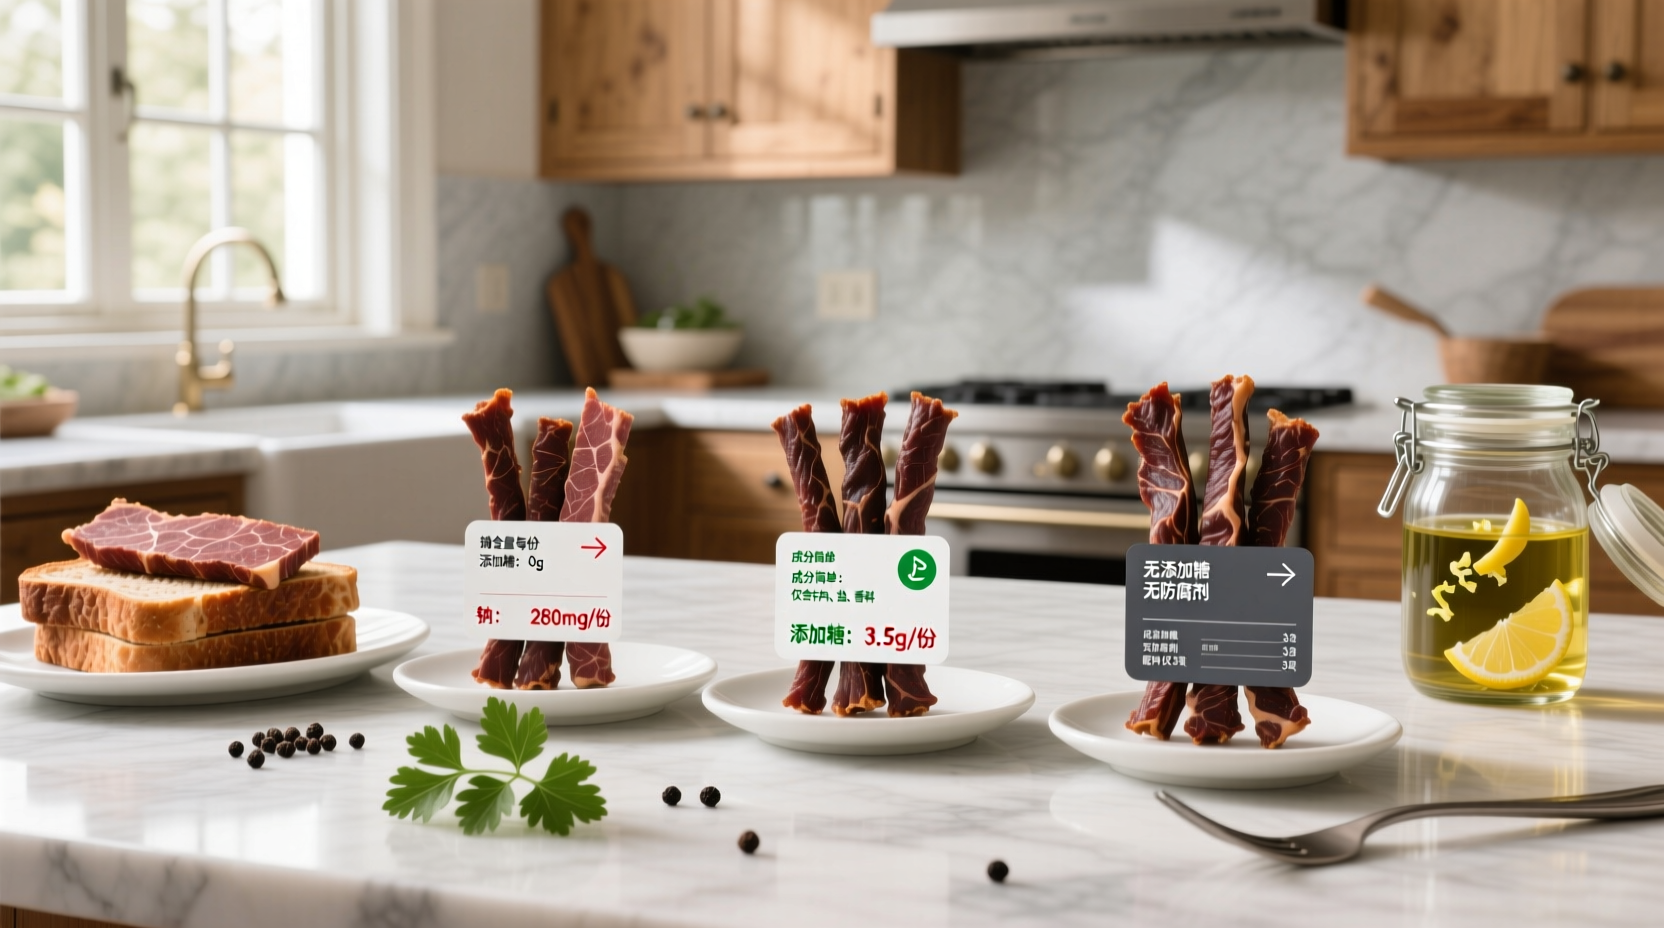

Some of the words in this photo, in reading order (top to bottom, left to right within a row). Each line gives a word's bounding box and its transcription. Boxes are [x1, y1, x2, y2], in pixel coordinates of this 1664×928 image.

[528, 555, 544, 571] 0g
[530, 608, 611, 630] 280mg/份
[864, 626, 937, 651] 3.5g/份
